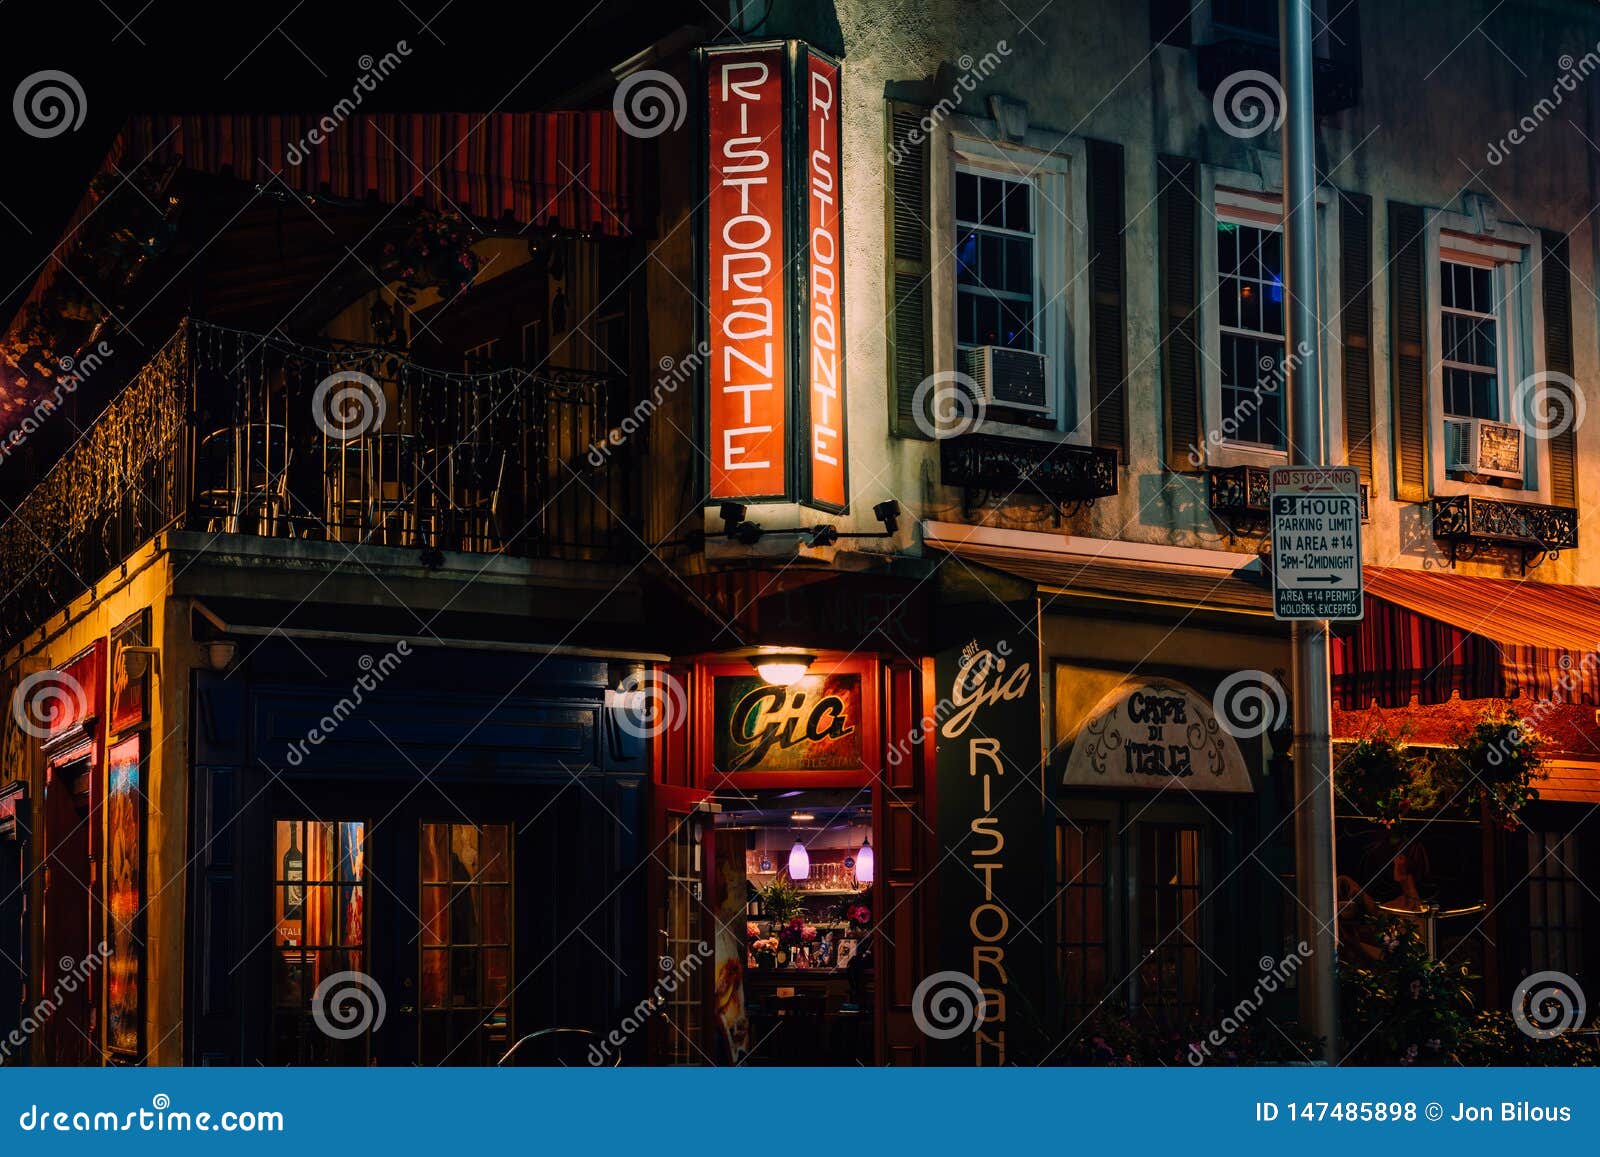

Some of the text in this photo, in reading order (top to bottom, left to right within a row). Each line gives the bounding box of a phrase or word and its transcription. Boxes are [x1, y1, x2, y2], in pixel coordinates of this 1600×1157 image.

[1275, 471, 1351, 485] NO STOPPING
[1279, 498, 1351, 515] 3 HOUR
[1278, 518, 1353, 532] PARKING LIMIT
[1280, 536, 1353, 551] IN AREA #14
[1280, 554, 1354, 569] 5PM-12MIDNIGHT
[1280, 590, 1356, 601] AREA #14 PERMIT
[1280, 604, 1357, 614] HOLDERS EXCEPTED
[942, 649, 1031, 738] Gia
[730, 685, 856, 770] Gia
[1148, 726, 1164, 741] DI
